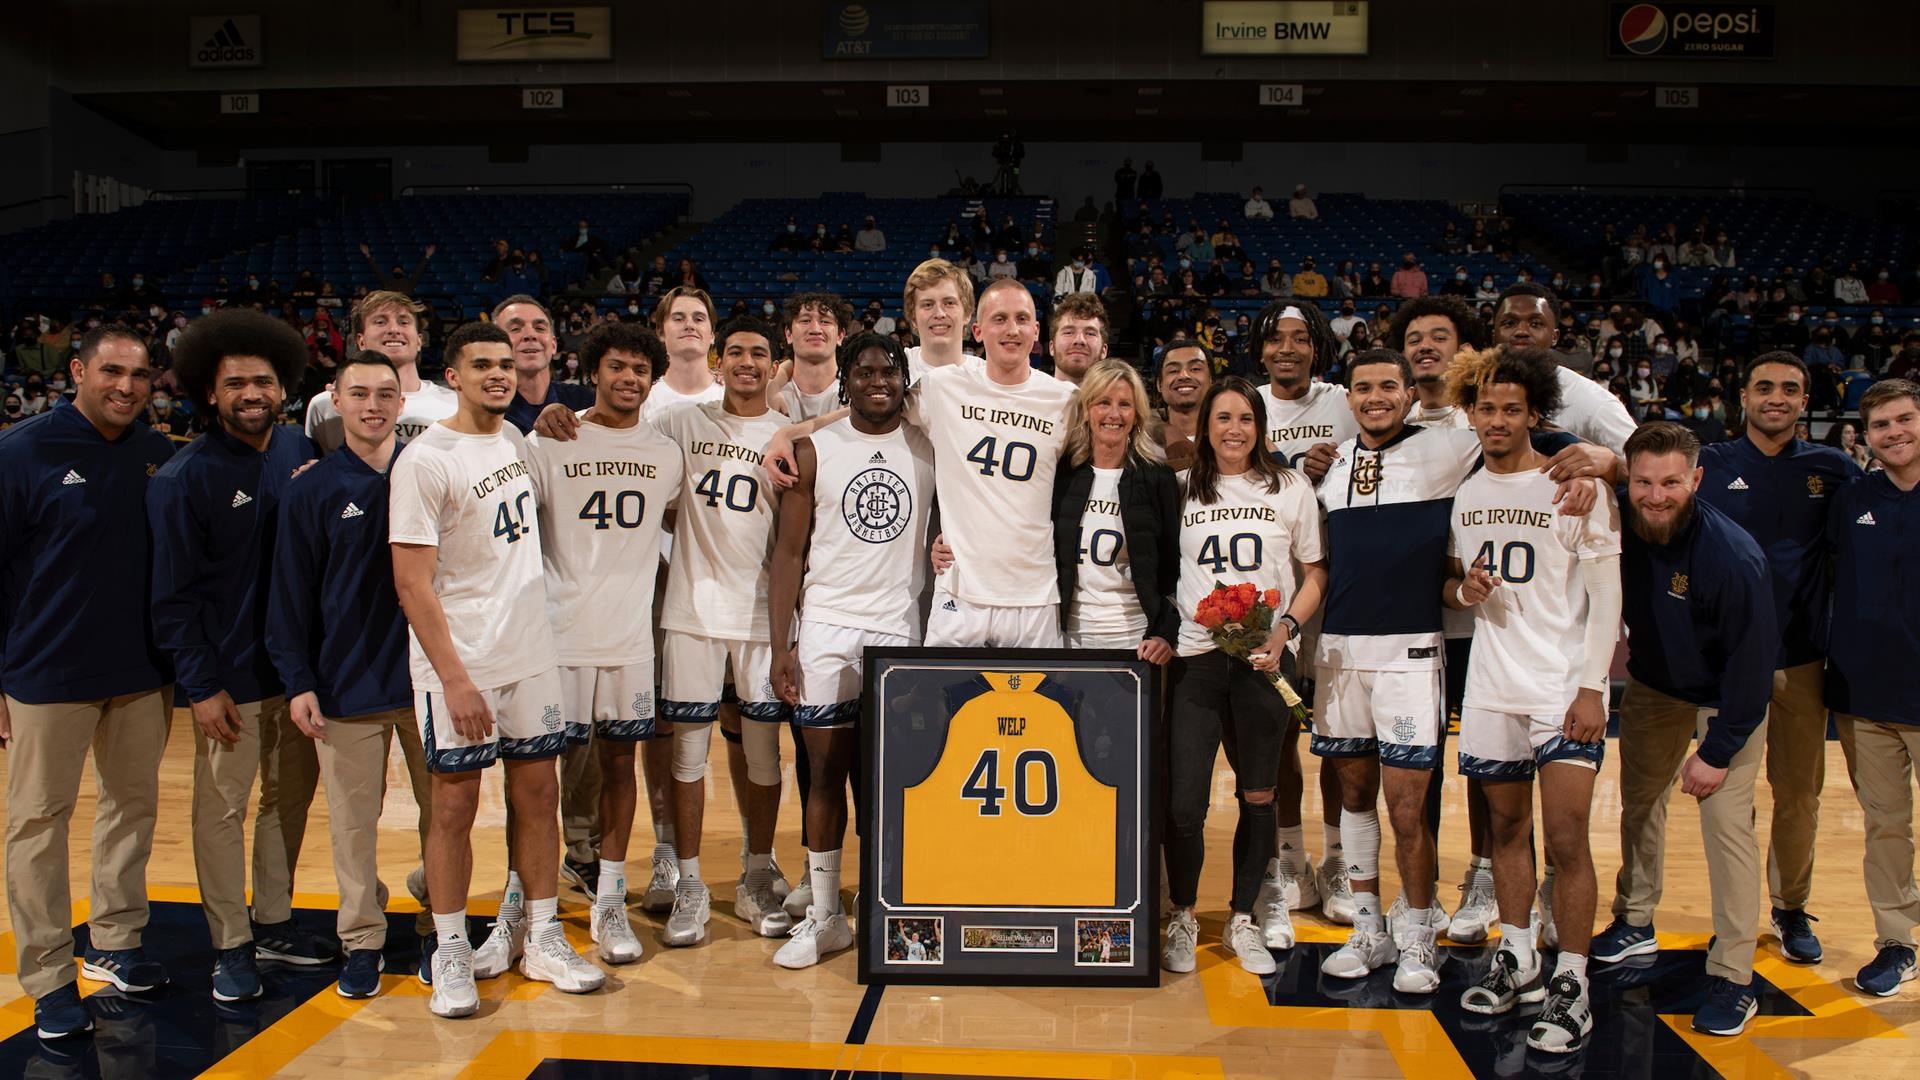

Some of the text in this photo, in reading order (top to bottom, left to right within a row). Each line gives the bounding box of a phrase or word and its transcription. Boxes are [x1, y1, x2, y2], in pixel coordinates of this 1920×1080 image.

[497, 12, 575, 35] TCS
[1216, 22, 1331, 40] Irvine BMW
[1672, 7, 1758, 40] pepsi
[198, 47, 254, 62] adidas
[835, 40, 872, 55] AT&T
[1684, 43, 1744, 52] ZERO SUGAR
[230, 96, 249, 111] 101
[530, 91, 555, 106] 102
[895, 88, 920, 104] 103
[1268, 87, 1294, 103] 104
[1665, 90, 1690, 105] 105
[961, 405, 1054, 436] UC IRVINE
[395, 423, 428, 437] RVI
[1272, 425, 1333, 442] IRVINE
[691, 441, 765, 466] UC IRVIN
[966, 436, 1037, 481] 40
[563, 461, 656, 479] UC IRVINE
[473, 460, 529, 499] UC IRVIN
[695, 469, 759, 512] 40
[579, 490, 645, 530] 40
[1085, 500, 1120, 516] RVI
[1184, 507, 1275, 527] UC IRVINE
[1461, 508, 1552, 529] UC IRVINE
[1197, 532, 1262, 574] 40
[1471, 540, 1535, 583] 40
[997, 717, 1025, 735] WELP
[960, 748, 1059, 817] 40
[1039, 935, 1053, 944] 40
